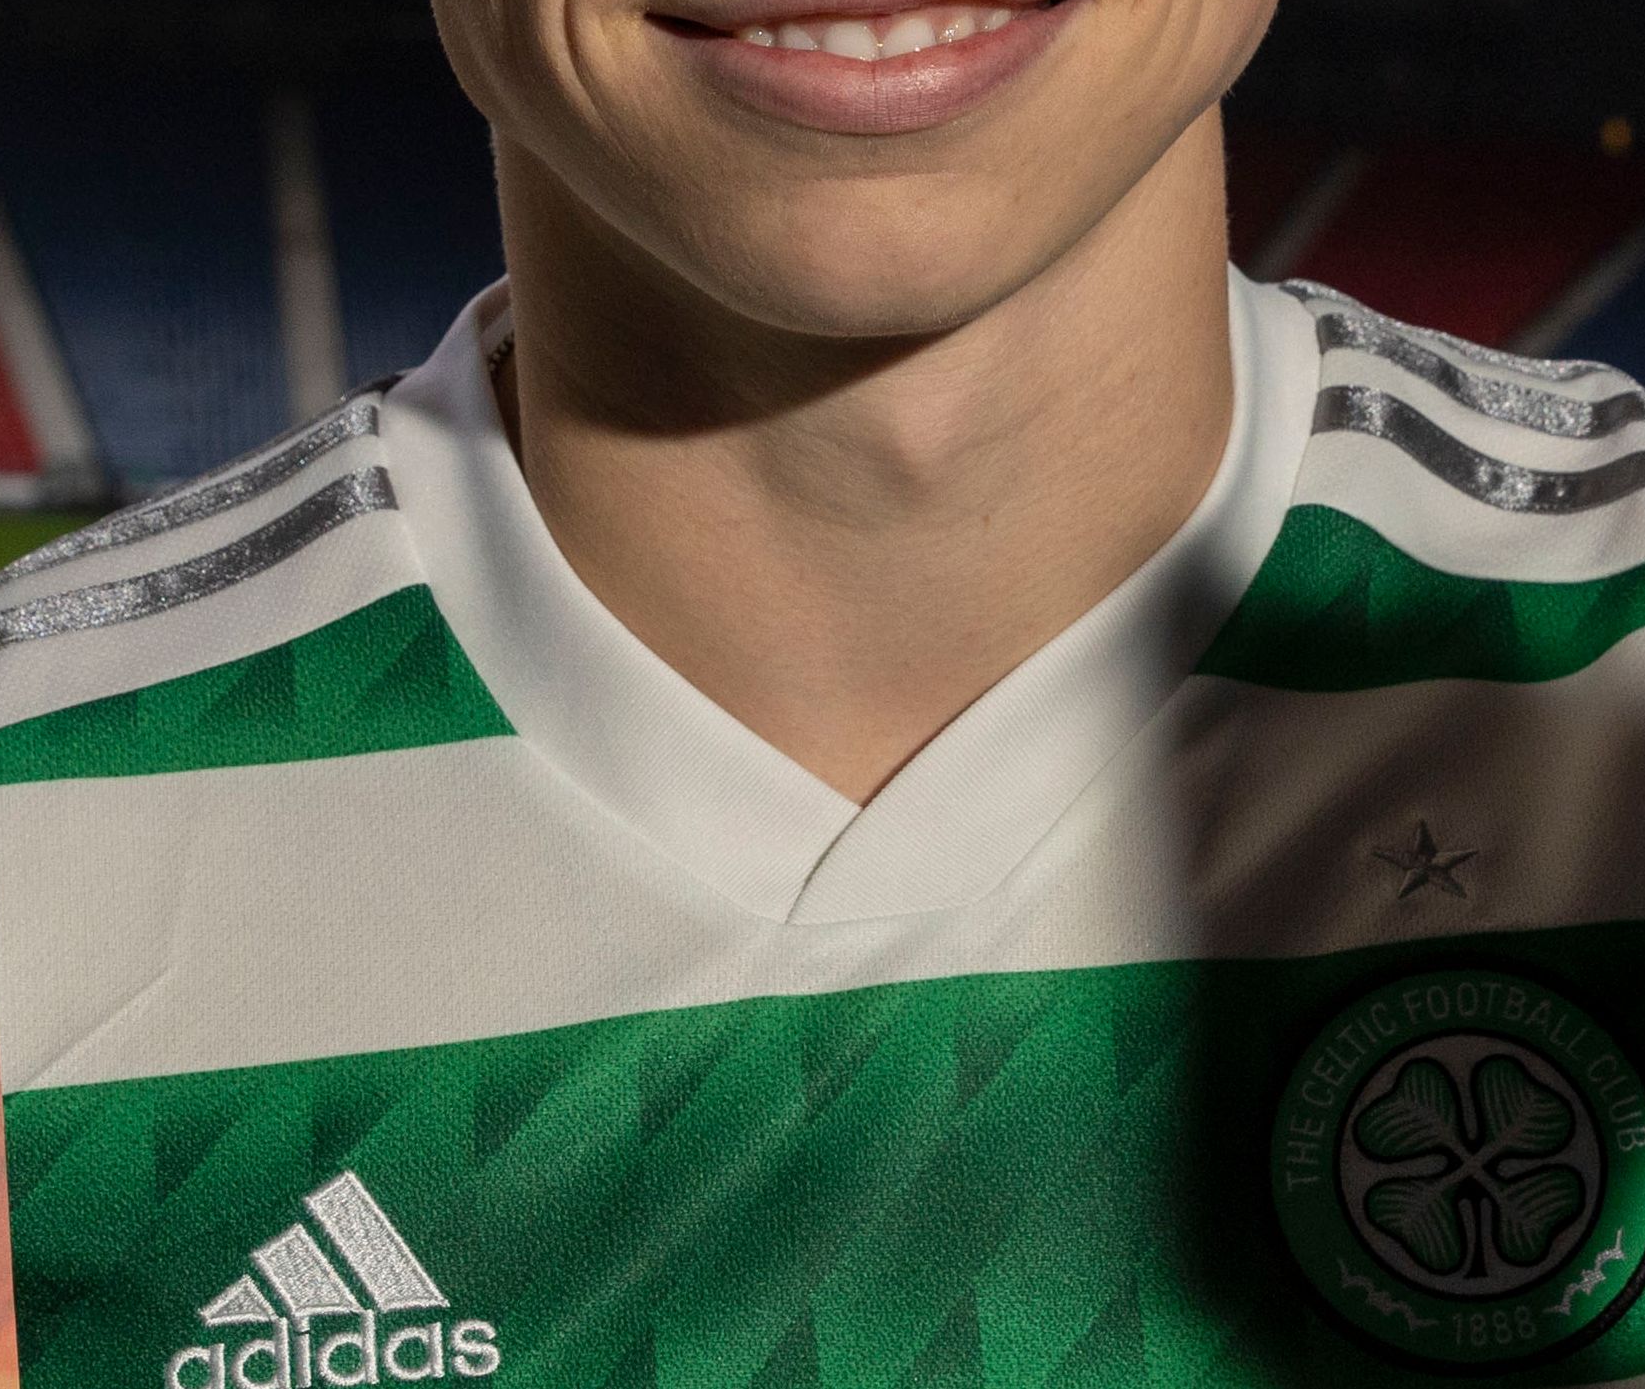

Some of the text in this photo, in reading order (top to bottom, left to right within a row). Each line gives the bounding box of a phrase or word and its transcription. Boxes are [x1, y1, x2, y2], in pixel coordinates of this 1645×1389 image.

[1303, 1002, 1398, 1109] CELTIC
[1403, 981, 1588, 1060] FOOTBALL
[1287, 1115, 1326, 1192] THE
[164, 1310, 501, 1389] adidas
